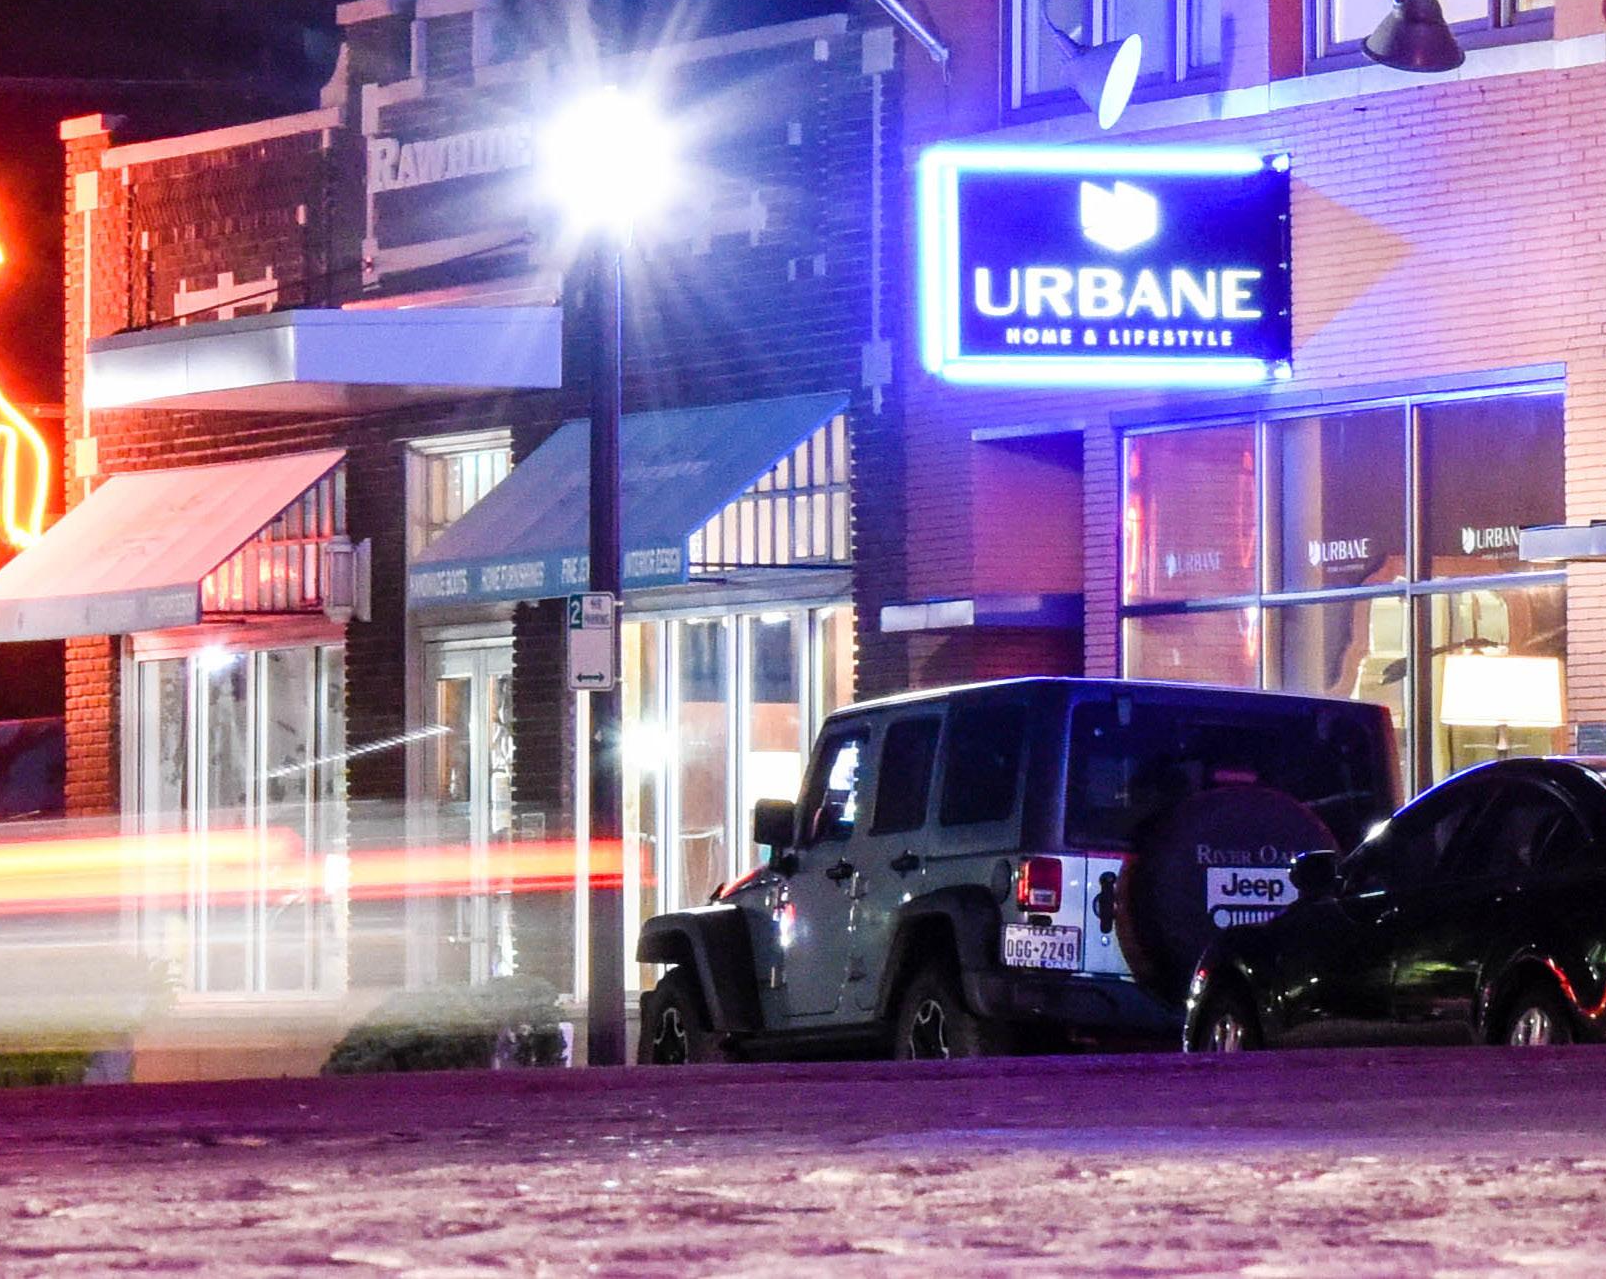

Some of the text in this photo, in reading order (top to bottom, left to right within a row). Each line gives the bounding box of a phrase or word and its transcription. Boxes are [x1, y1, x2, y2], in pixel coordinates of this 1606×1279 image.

[974, 267, 1263, 319] URBANE
[1005, 328, 1233, 346] HOME & LIFESTYLE
[1476, 526, 1520, 549] URBAN
[571, 601, 580, 624] 2
[1197, 844, 1251, 864] RIVER
[1222, 873, 1284, 901] Jeep
